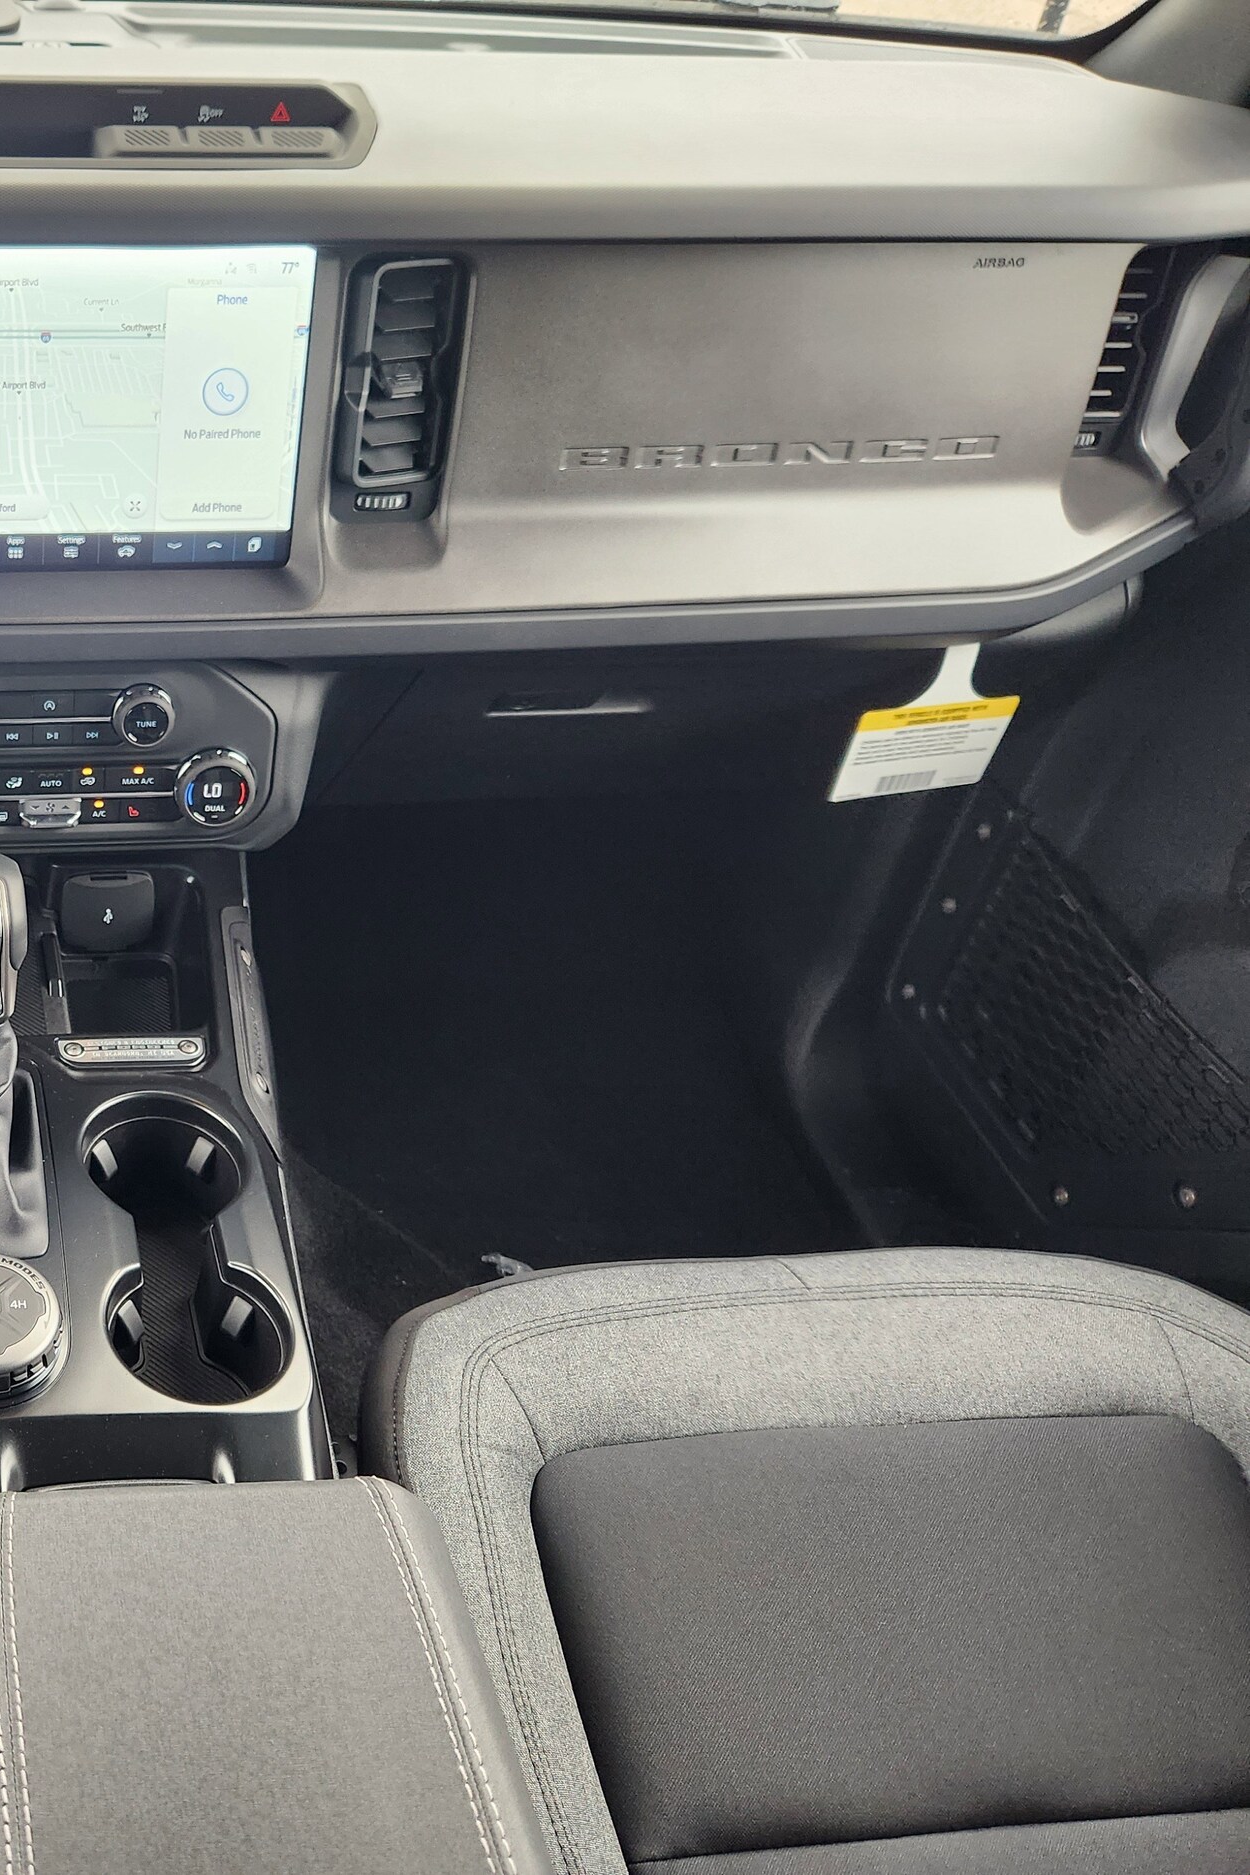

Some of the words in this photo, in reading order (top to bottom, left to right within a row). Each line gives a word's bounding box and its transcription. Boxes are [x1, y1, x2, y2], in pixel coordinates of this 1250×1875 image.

[972, 257, 1025, 269] AIRBAG
[21, 278, 39, 287] Blvd
[217, 294, 248, 305] Phone
[121, 323, 161, 333] Southwest
[2, 381, 29, 391] Airport
[29, 381, 46, 390] Blvd
[183, 429, 197, 440] No
[199, 428, 229, 440] Paired
[231, 428, 261, 440] Phone
[558, 434, 1000, 471] BRONCO
[192, 503, 212, 513] Add
[214, 503, 242, 513] Phone
[6, 536, 25, 547] Apps
[57, 535, 86, 546] Settings
[112, 534, 142, 544] Features
[136, 720, 157, 728] TUNE
[40, 780, 62, 788] AUTO
[122, 778, 140, 786] MAX
[141, 777, 155, 786] A/C
[202, 782, 222, 798] LO
[204, 804, 226, 813] DUAL
[92, 810, 107, 818] A/C
[1, 1258, 45, 1290] MODES
[10, 1300, 27, 1309] 4H
